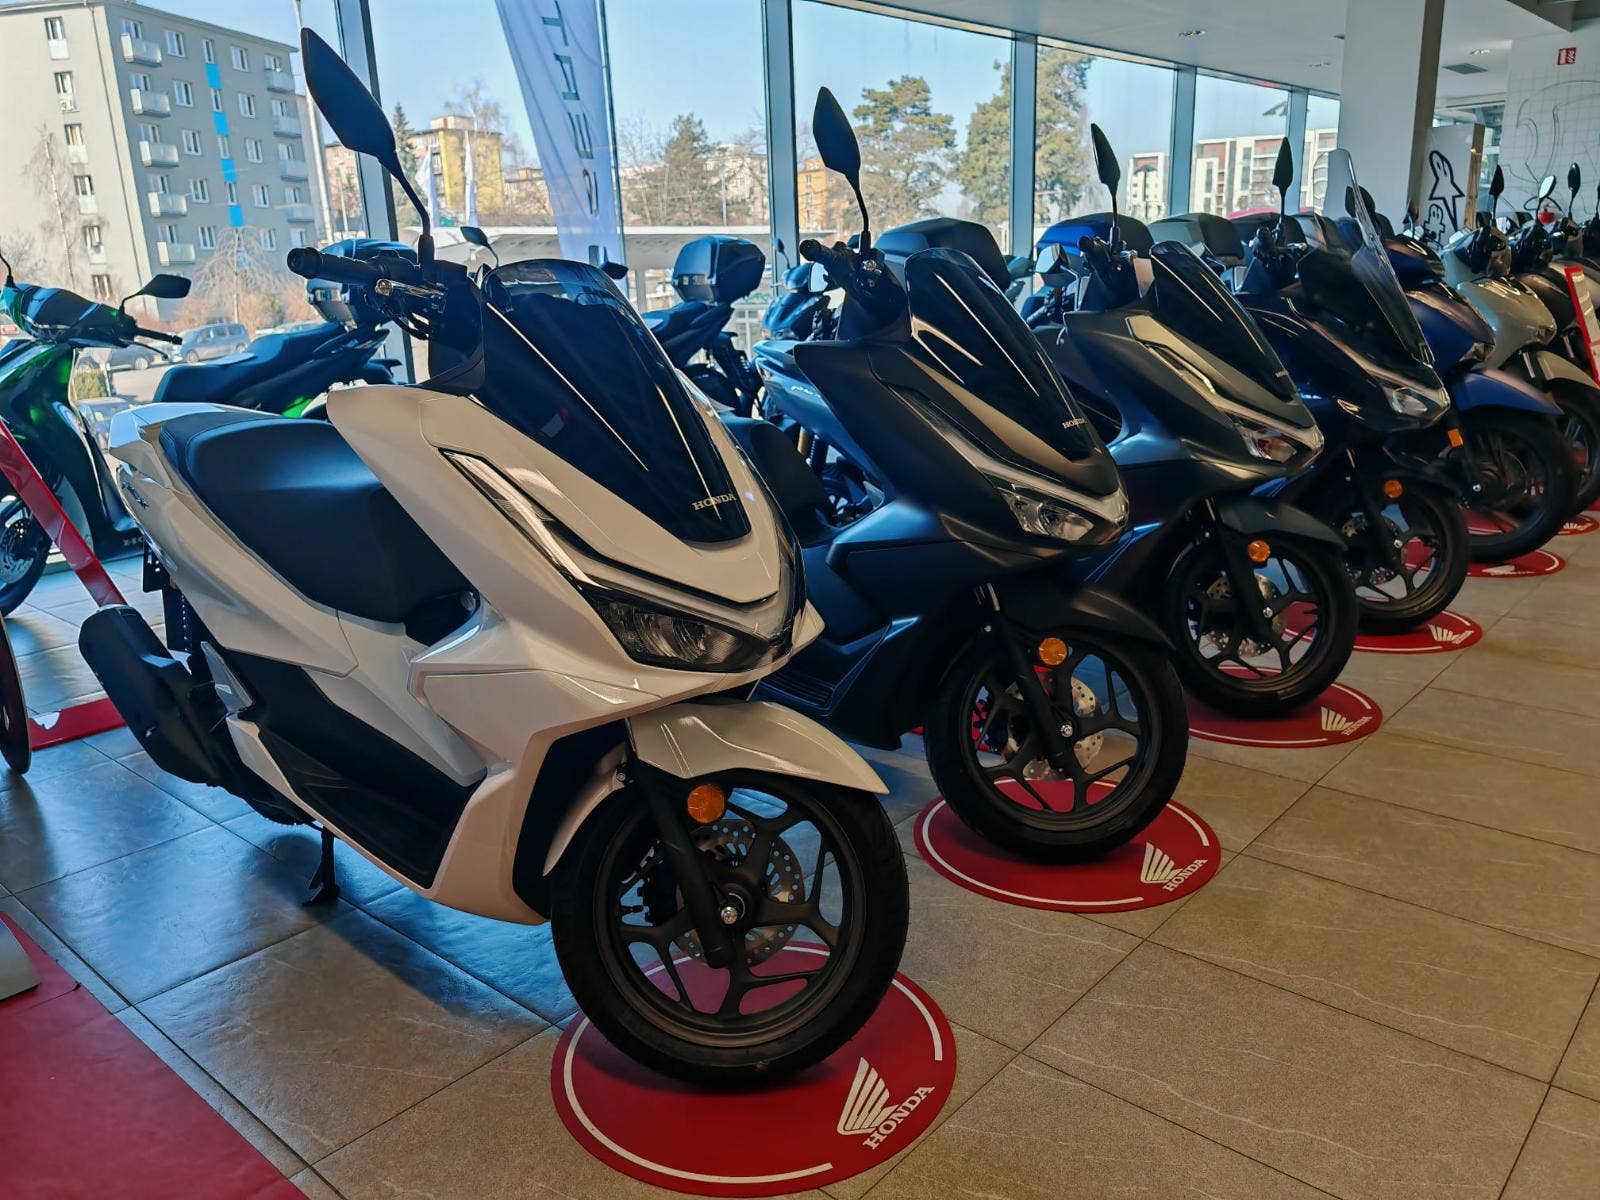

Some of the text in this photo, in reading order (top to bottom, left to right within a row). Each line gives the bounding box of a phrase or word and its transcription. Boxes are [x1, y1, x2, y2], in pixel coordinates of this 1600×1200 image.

[692, 493, 736, 511] HONDA
[1162, 859, 1208, 892] HONDA
[862, 1086, 935, 1150] HONDA
